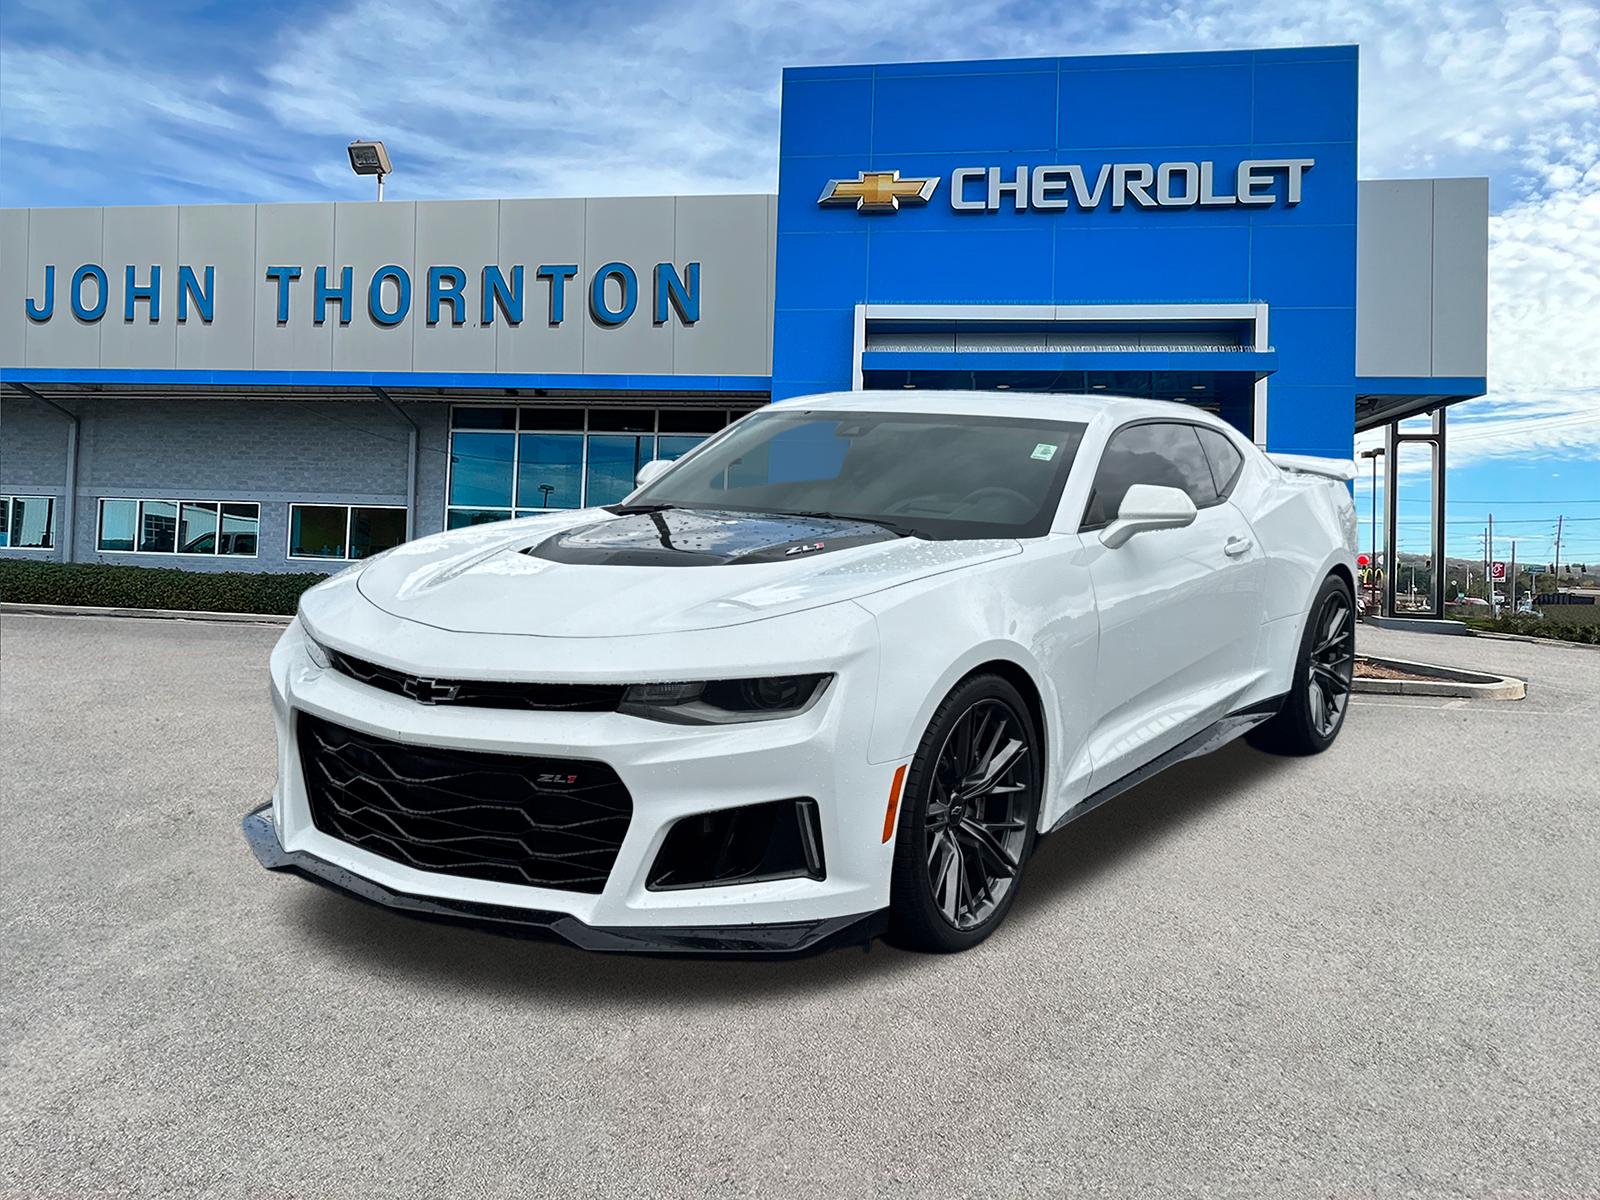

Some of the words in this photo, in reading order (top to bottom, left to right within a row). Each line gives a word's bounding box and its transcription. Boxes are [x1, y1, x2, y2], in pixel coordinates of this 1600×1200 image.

[951, 158, 1315, 212] CHEVROLET
[26, 264, 214, 323] JOHN
[266, 262, 701, 327] THORNTON
[785, 542, 825, 556] ZL1
[537, 774, 577, 785] ZL1
